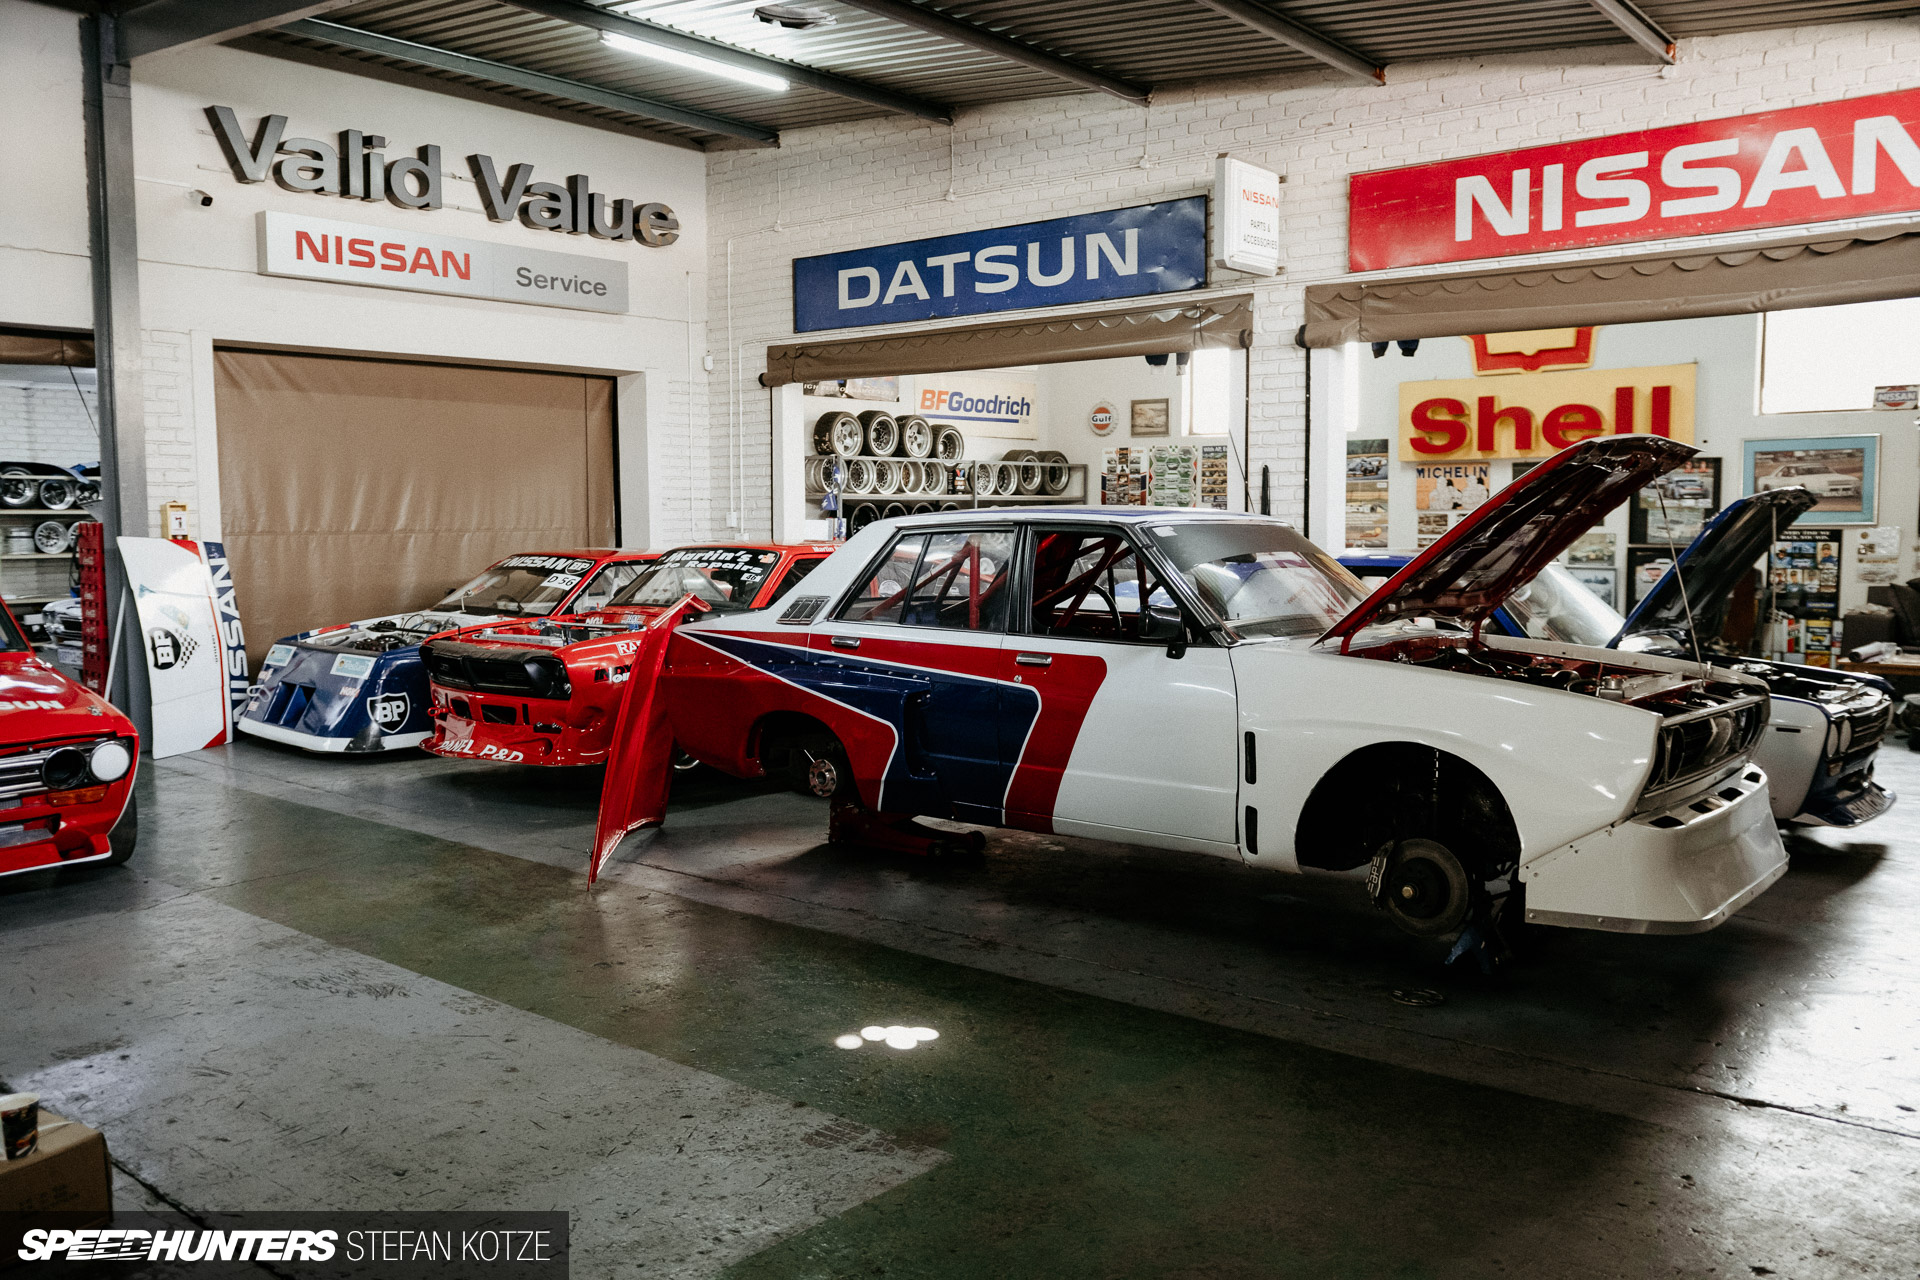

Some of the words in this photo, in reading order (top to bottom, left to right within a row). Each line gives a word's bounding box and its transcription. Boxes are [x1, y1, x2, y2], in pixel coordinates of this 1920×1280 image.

[203, 104, 442, 211] Valid
[467, 153, 680, 248] Value
[1455, 115, 1920, 242] NISSAN
[1242, 189, 1279, 208] NISSAN
[1243, 233, 1278, 250] ACCESSORIES
[295, 230, 471, 281] NISSAN
[516, 266, 608, 297] Service
[838, 228, 1139, 310] DATSUN
[920, 389, 1031, 416] BFGoodrich
[1878, 392, 1916, 402] NISSAN
[1091, 414, 1112, 423] Gulf
[1409, 385, 1671, 455] Shell
[1416, 466, 1488, 479] MICHELIN
[503, 556, 572, 571] NISSAN
[570, 561, 590, 571] BP
[663, 550, 753, 563] Martin's
[685, 560, 763, 574] Repairs
[152, 629, 176, 667] BP
[375, 700, 405, 723] BP
[436, 739, 475, 754] PANEL
[479, 744, 524, 762] P&D
